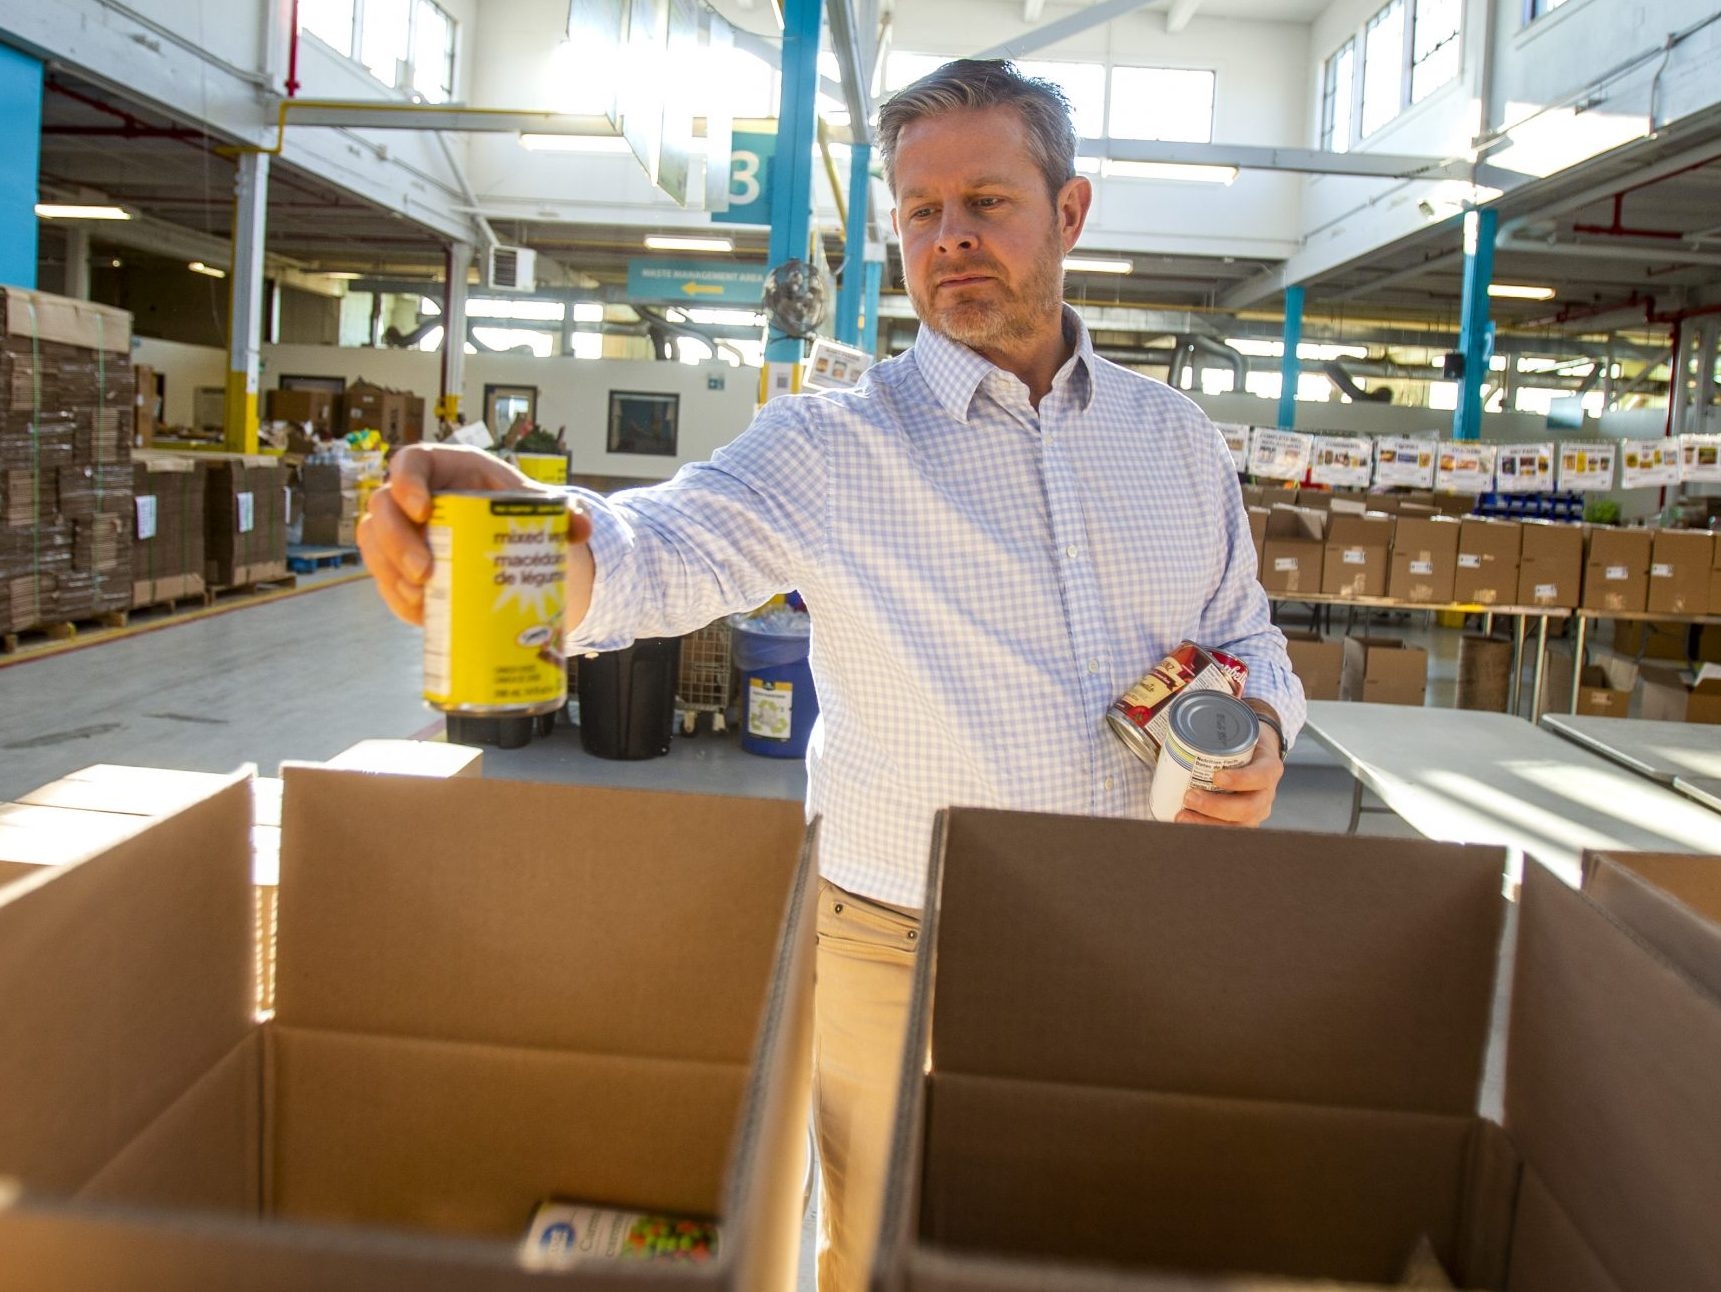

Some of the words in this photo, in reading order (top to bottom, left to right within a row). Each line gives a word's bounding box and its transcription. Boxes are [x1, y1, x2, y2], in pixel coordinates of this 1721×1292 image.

[729, 149, 760, 205] 3
[641, 268, 672, 279] WASTE
[673, 270, 737, 281] MANAGEMENT
[739, 273, 764, 283] AREA
[494, 528, 545, 544] mixed
[494, 571, 516, 586] de
